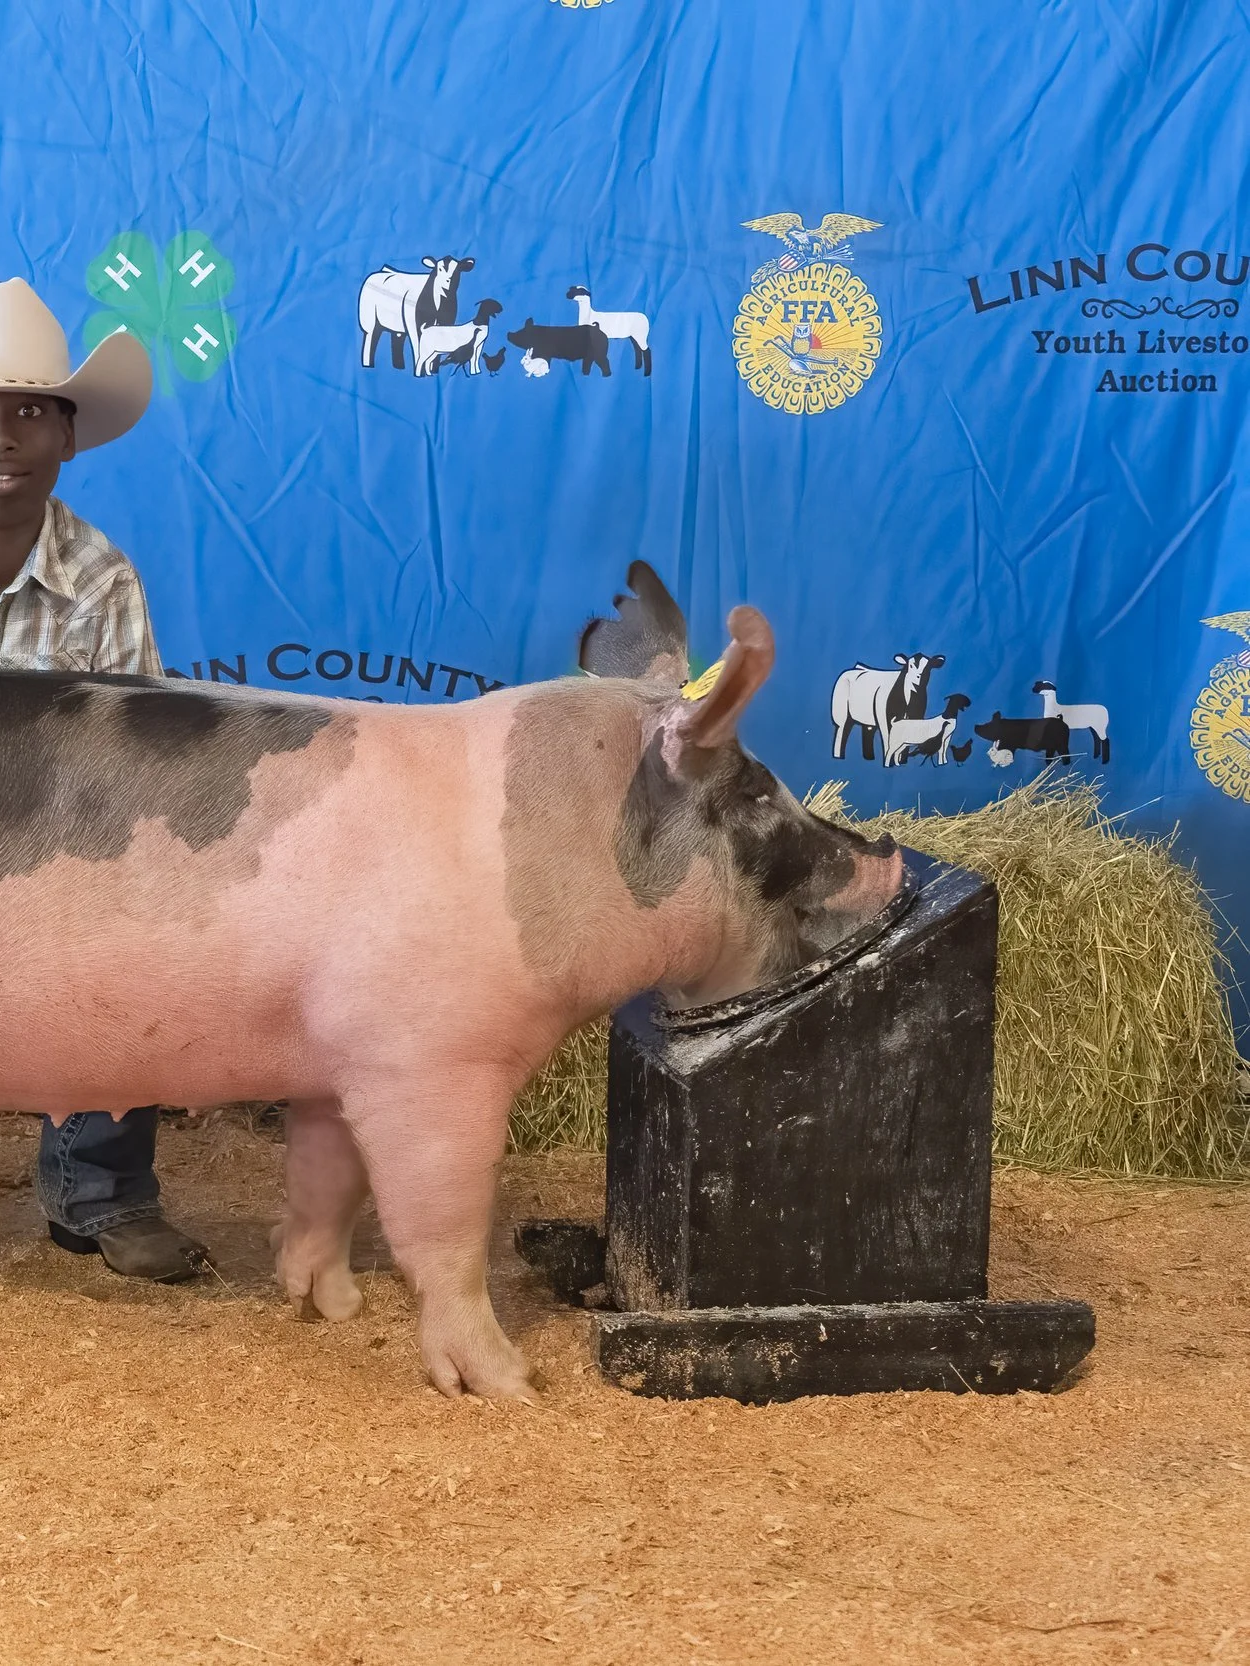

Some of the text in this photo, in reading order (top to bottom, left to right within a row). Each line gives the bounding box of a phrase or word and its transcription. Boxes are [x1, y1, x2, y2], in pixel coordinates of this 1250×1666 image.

[104, 249, 216, 292] H H
[967, 243, 1250, 314] LINN COU
[755, 280, 862, 327] AGRICULTURAL
[781, 300, 839, 323] FFA
[182, 322, 220, 362] H
[1031, 328, 1248, 354] Youth Livesto
[762, 363, 851, 393] EDUCATION
[1095, 368, 1217, 392] Auction
[267, 643, 507, 697] COUNTY
